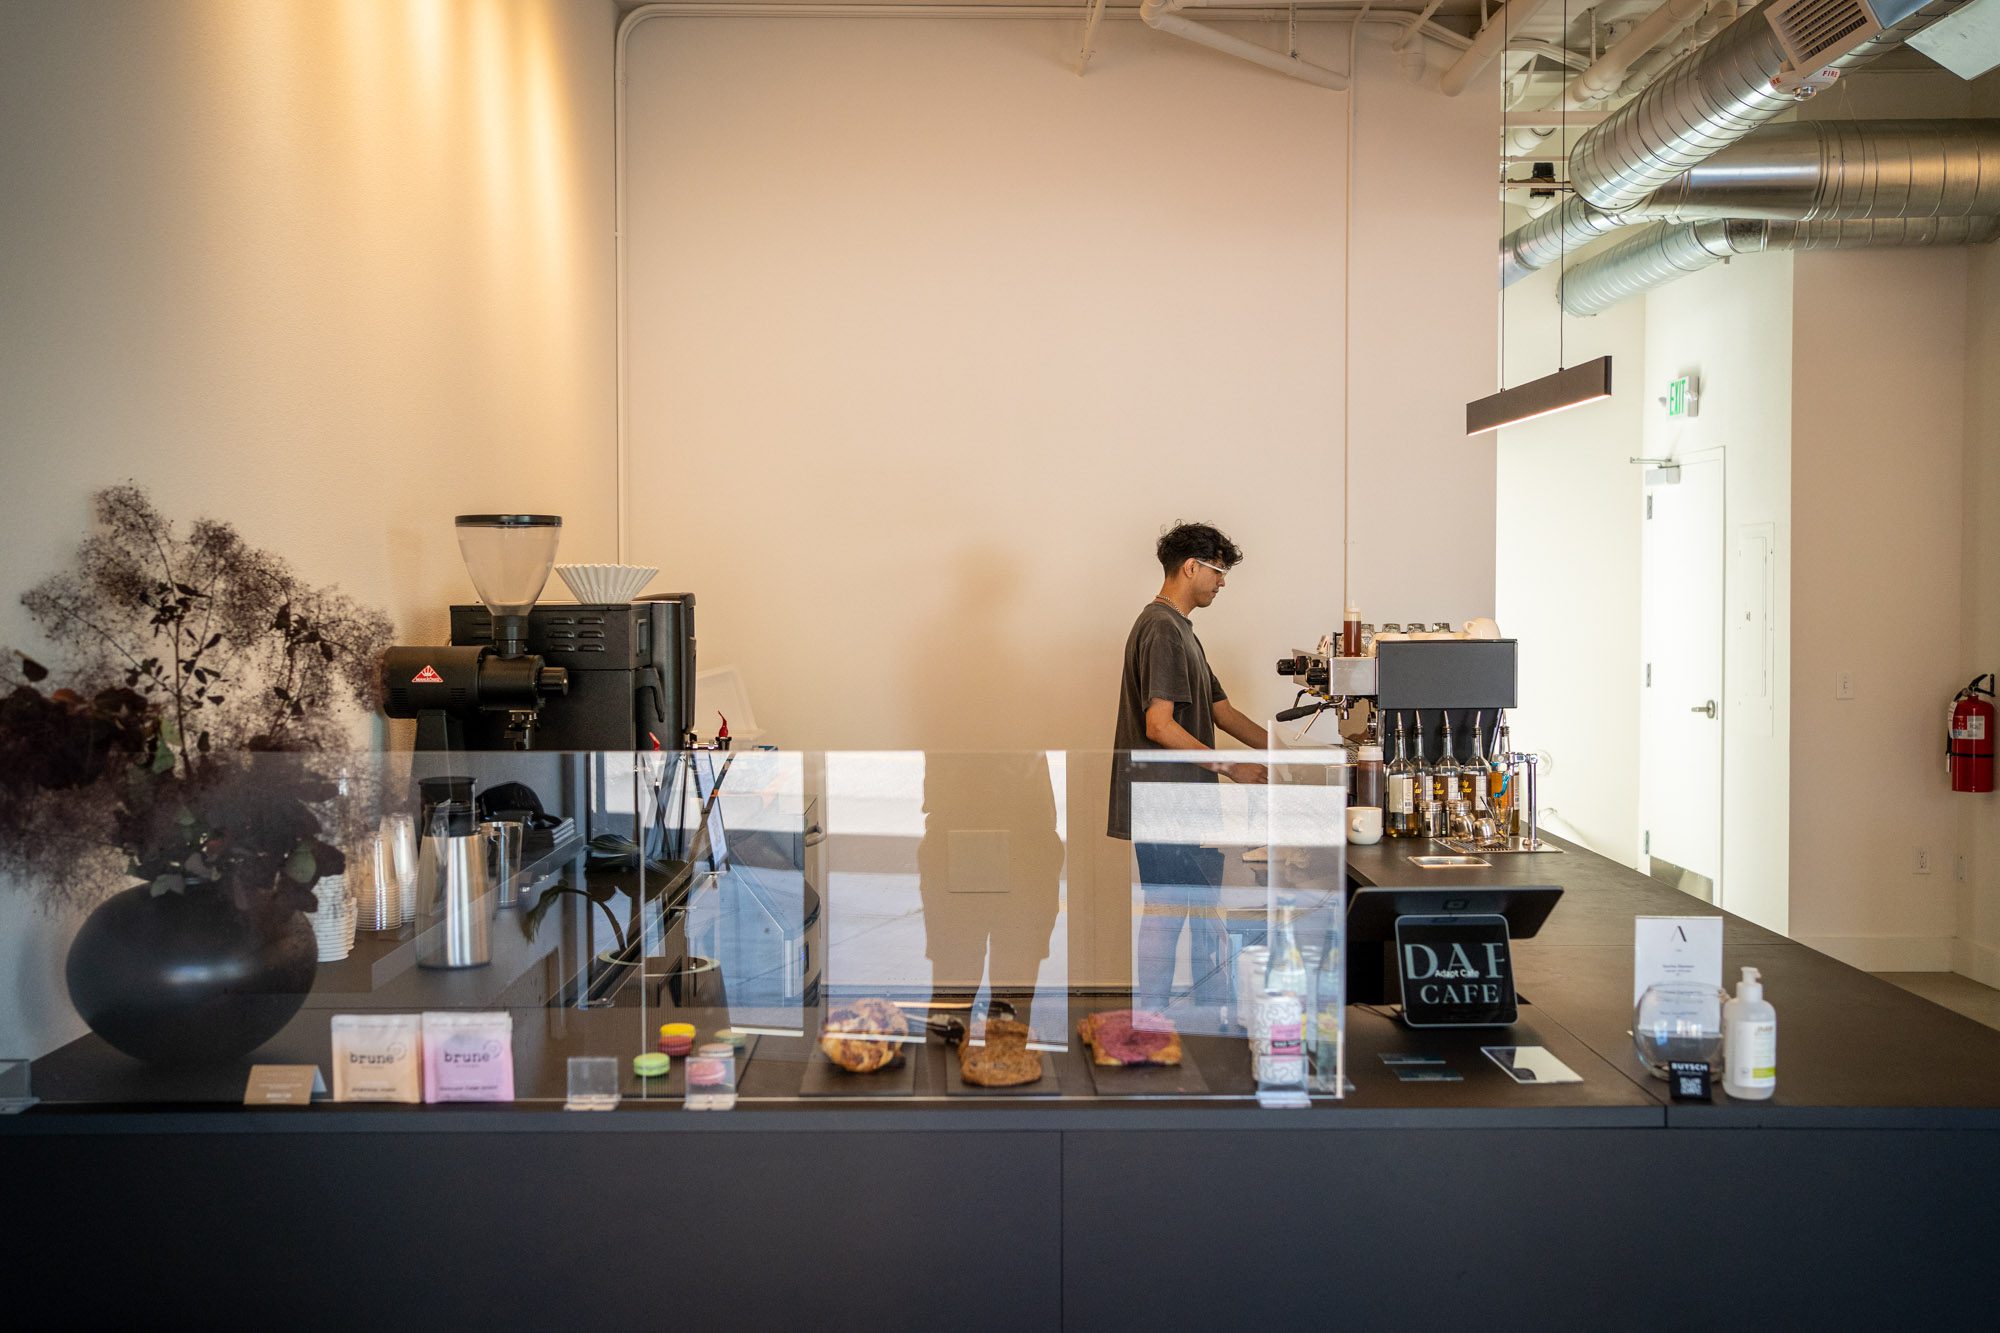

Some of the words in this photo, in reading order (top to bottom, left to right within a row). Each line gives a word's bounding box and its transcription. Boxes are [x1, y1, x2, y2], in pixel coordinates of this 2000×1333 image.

[1822, 70, 1838, 78] FIRE
[1669, 379, 1686, 417] EXIT
[1420, 984, 1499, 1005] CAFE
[350, 1051, 395, 1065] brune
[443, 1050, 491, 1064] brune
